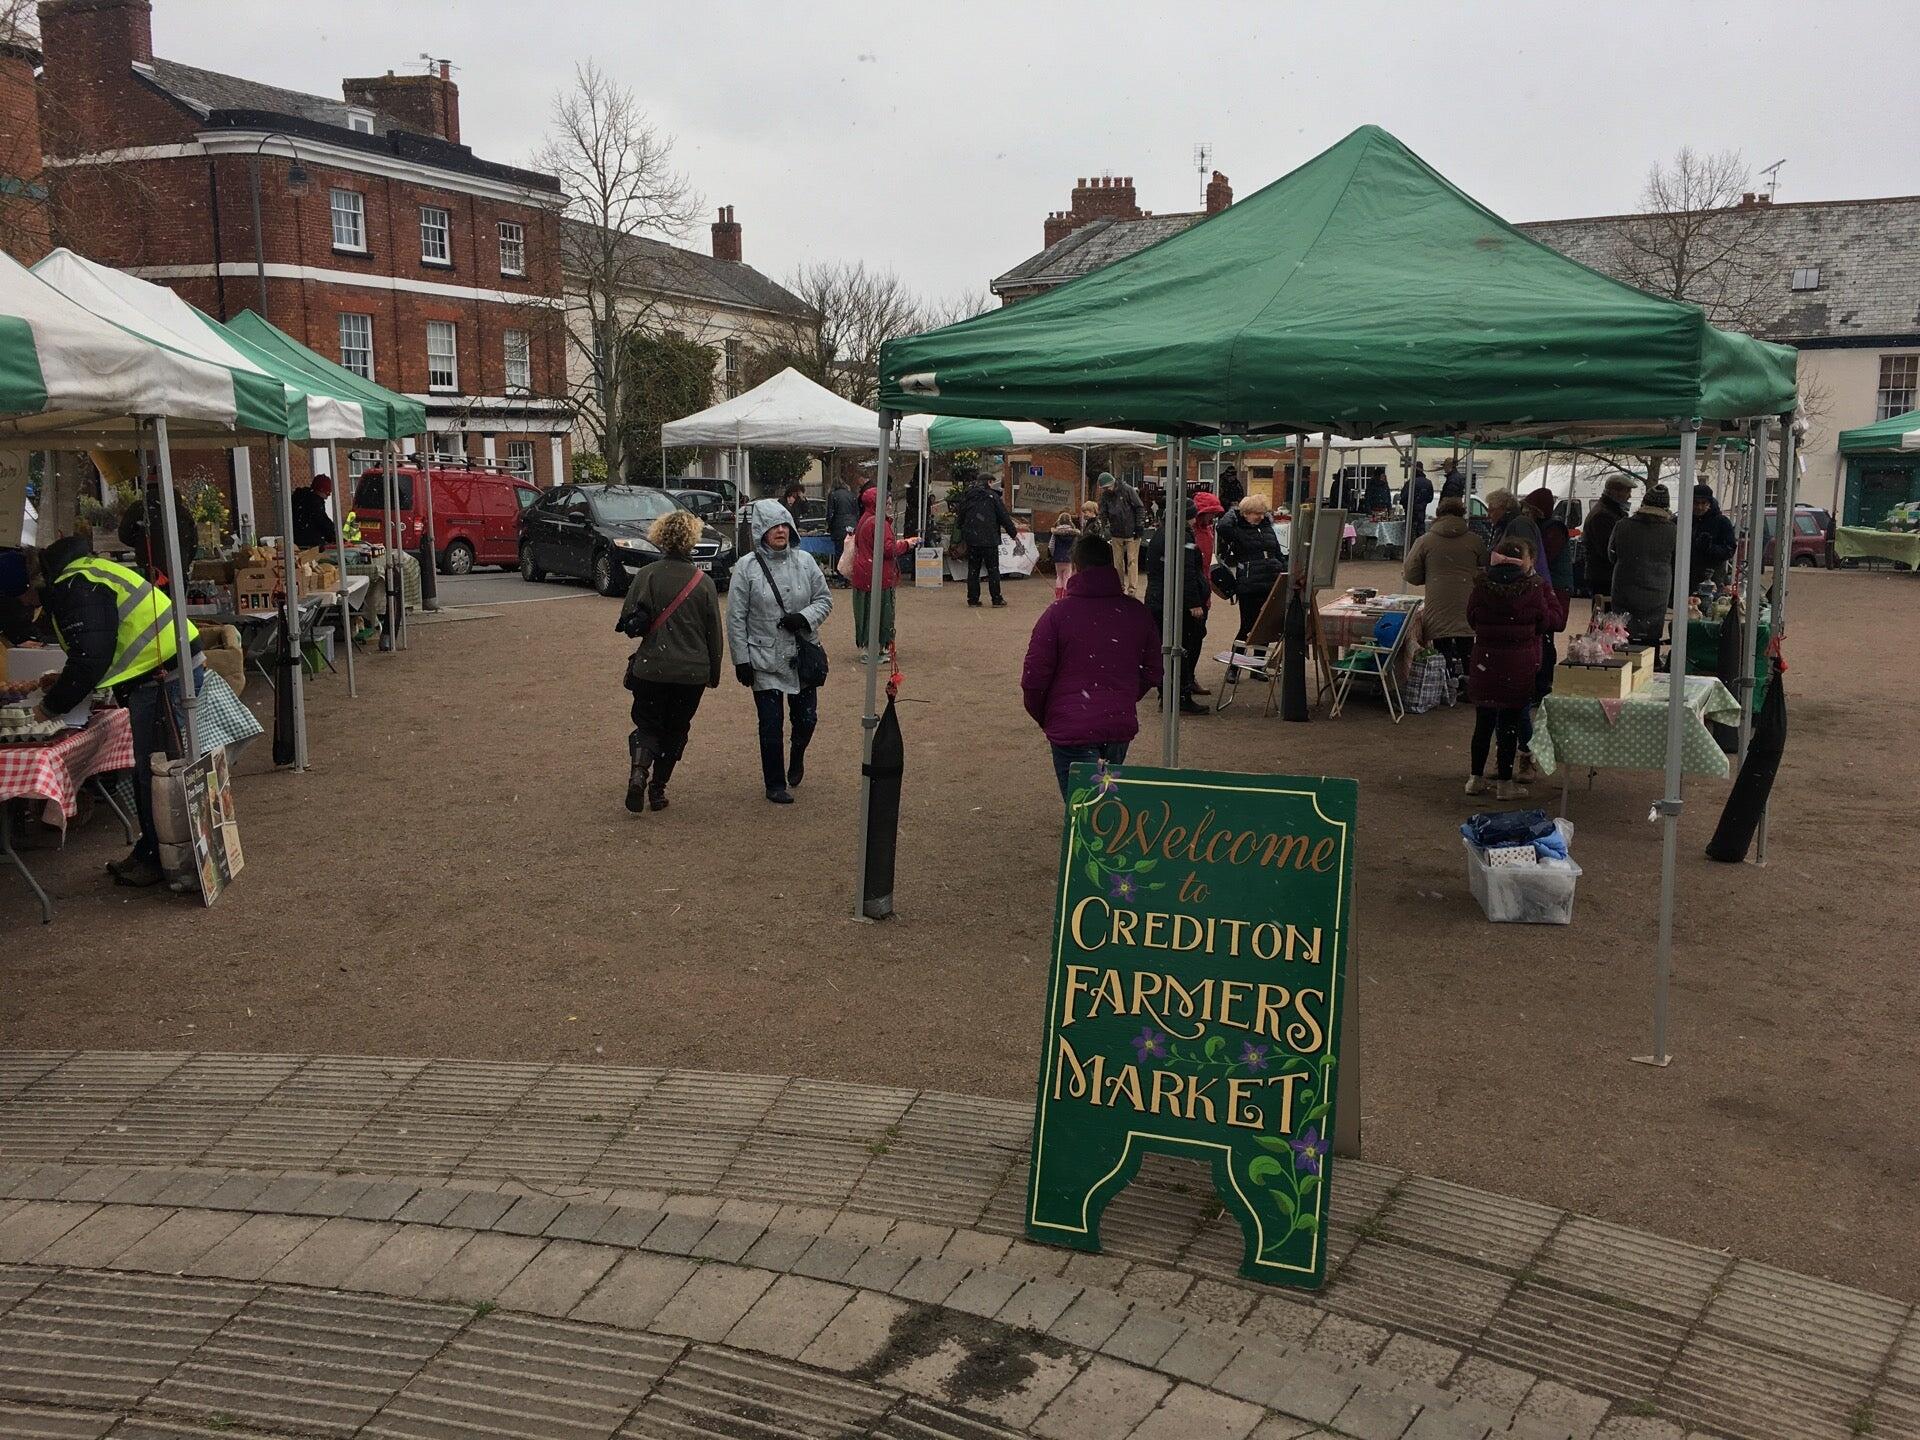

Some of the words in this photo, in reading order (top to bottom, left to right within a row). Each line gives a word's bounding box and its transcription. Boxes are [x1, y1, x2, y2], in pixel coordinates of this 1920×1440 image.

[1091, 800, 1336, 873] Welcome
[1178, 871, 1211, 903] to
[1071, 896, 1323, 965] CREDITON
[1061, 963, 1325, 1054] FARMERS
[1053, 1033, 1310, 1135] MARKET
